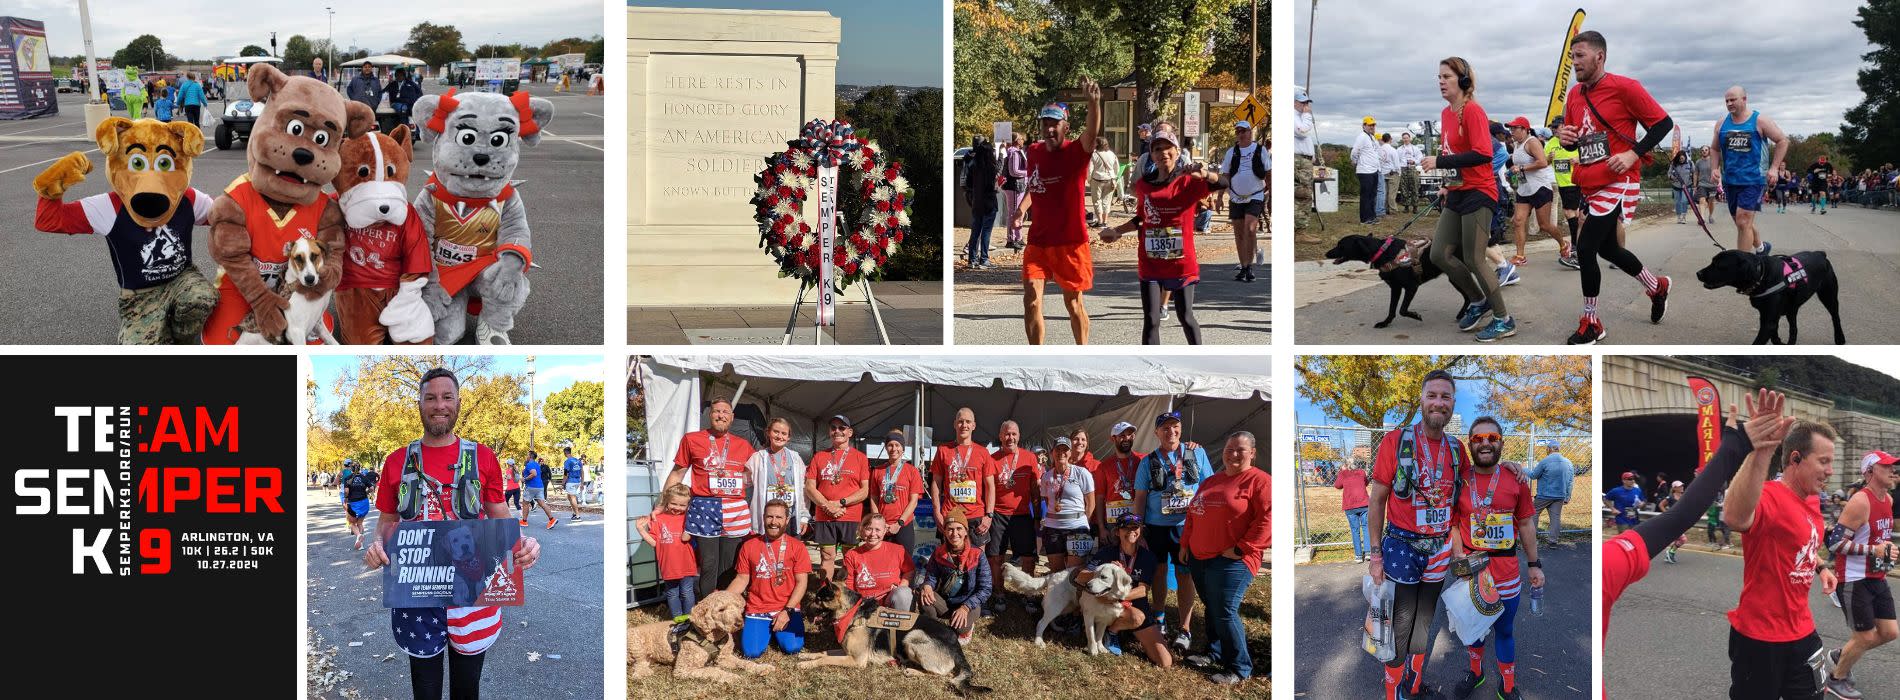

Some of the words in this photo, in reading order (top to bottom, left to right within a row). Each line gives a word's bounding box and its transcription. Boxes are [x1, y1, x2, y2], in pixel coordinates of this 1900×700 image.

[664, 76, 707, 89] HERE
[715, 77, 765, 90] RESTS
[771, 78, 788, 90] IN
[663, 102, 735, 116] HONORED
[741, 103, 789, 116] GLORY
[662, 129, 687, 144] AN
[692, 129, 788, 144] AMERICAN
[663, 186, 709, 198] KNOWN
[820, 176, 831, 263] SEMPER
[1150, 237, 1177, 251] 13857
[439, 247, 474, 263] 1943
[823, 278, 832, 305] K9
[717, 478, 737, 488] 5059
[953, 487, 972, 496] 11443
[397, 528, 436, 546] DON'T
[1486, 525, 1505, 539] 015
[398, 547, 431, 565] STOP
[398, 566, 456, 583] RUNNING
